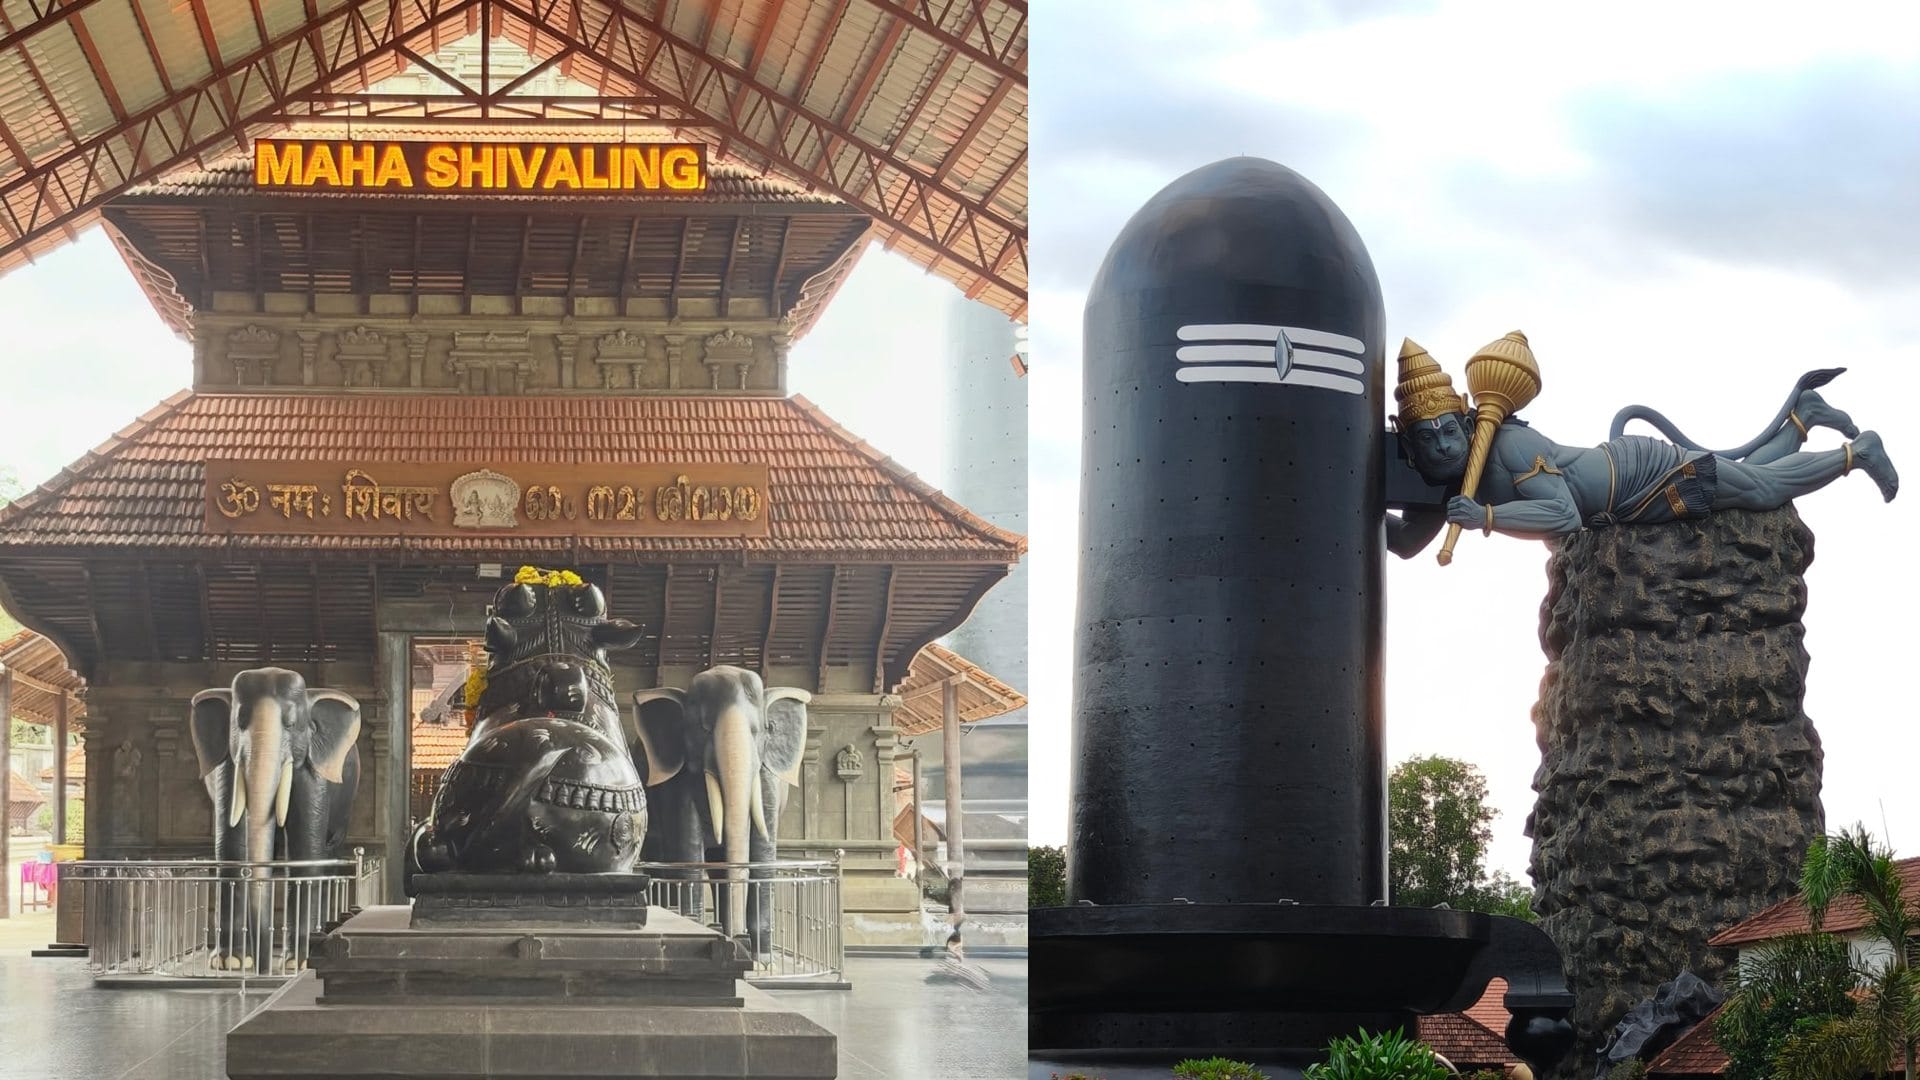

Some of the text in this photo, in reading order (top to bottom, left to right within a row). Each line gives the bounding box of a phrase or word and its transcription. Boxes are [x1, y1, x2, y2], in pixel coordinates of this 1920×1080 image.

[257, 144, 706, 190] MAHA SHIVALING
[216, 477, 260, 519] ॐ
[341, 468, 440, 522] शिवाय
[656, 474, 761, 522] ശിവായ
